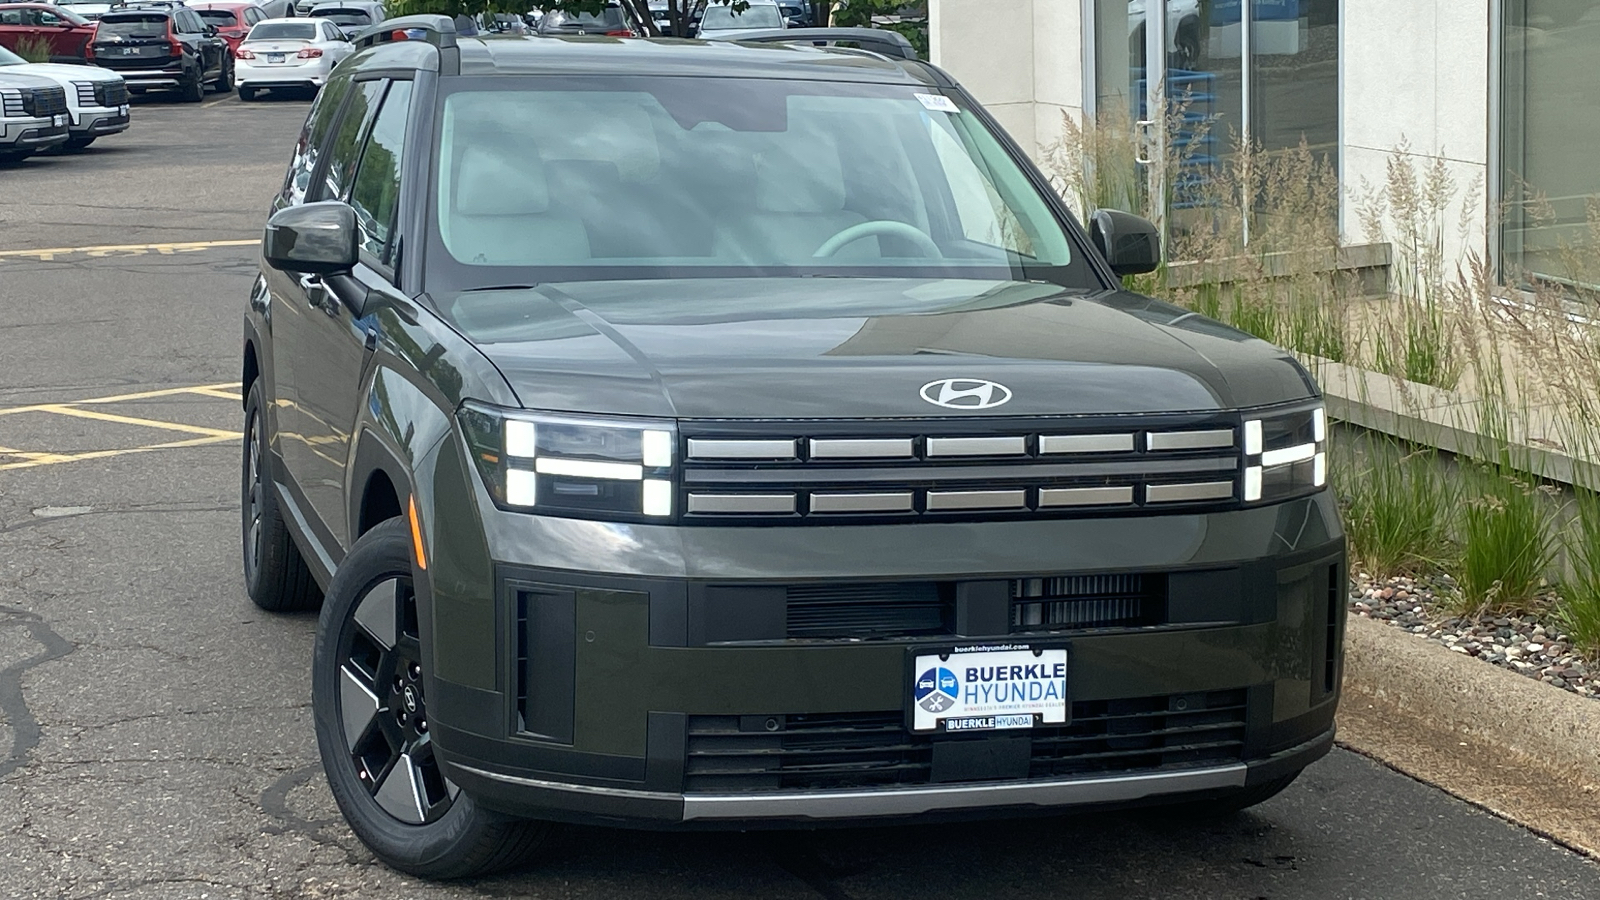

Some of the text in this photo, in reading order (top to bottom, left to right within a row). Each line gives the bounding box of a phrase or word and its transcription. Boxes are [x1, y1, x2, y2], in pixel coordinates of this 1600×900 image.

[954, 644, 1030, 653] buerklehyundai.com
[965, 663, 1065, 683] BUERKLE
[964, 680, 1065, 705] HYUNDAI
[948, 715, 1031, 730] BUERKLE HYUNDAI
